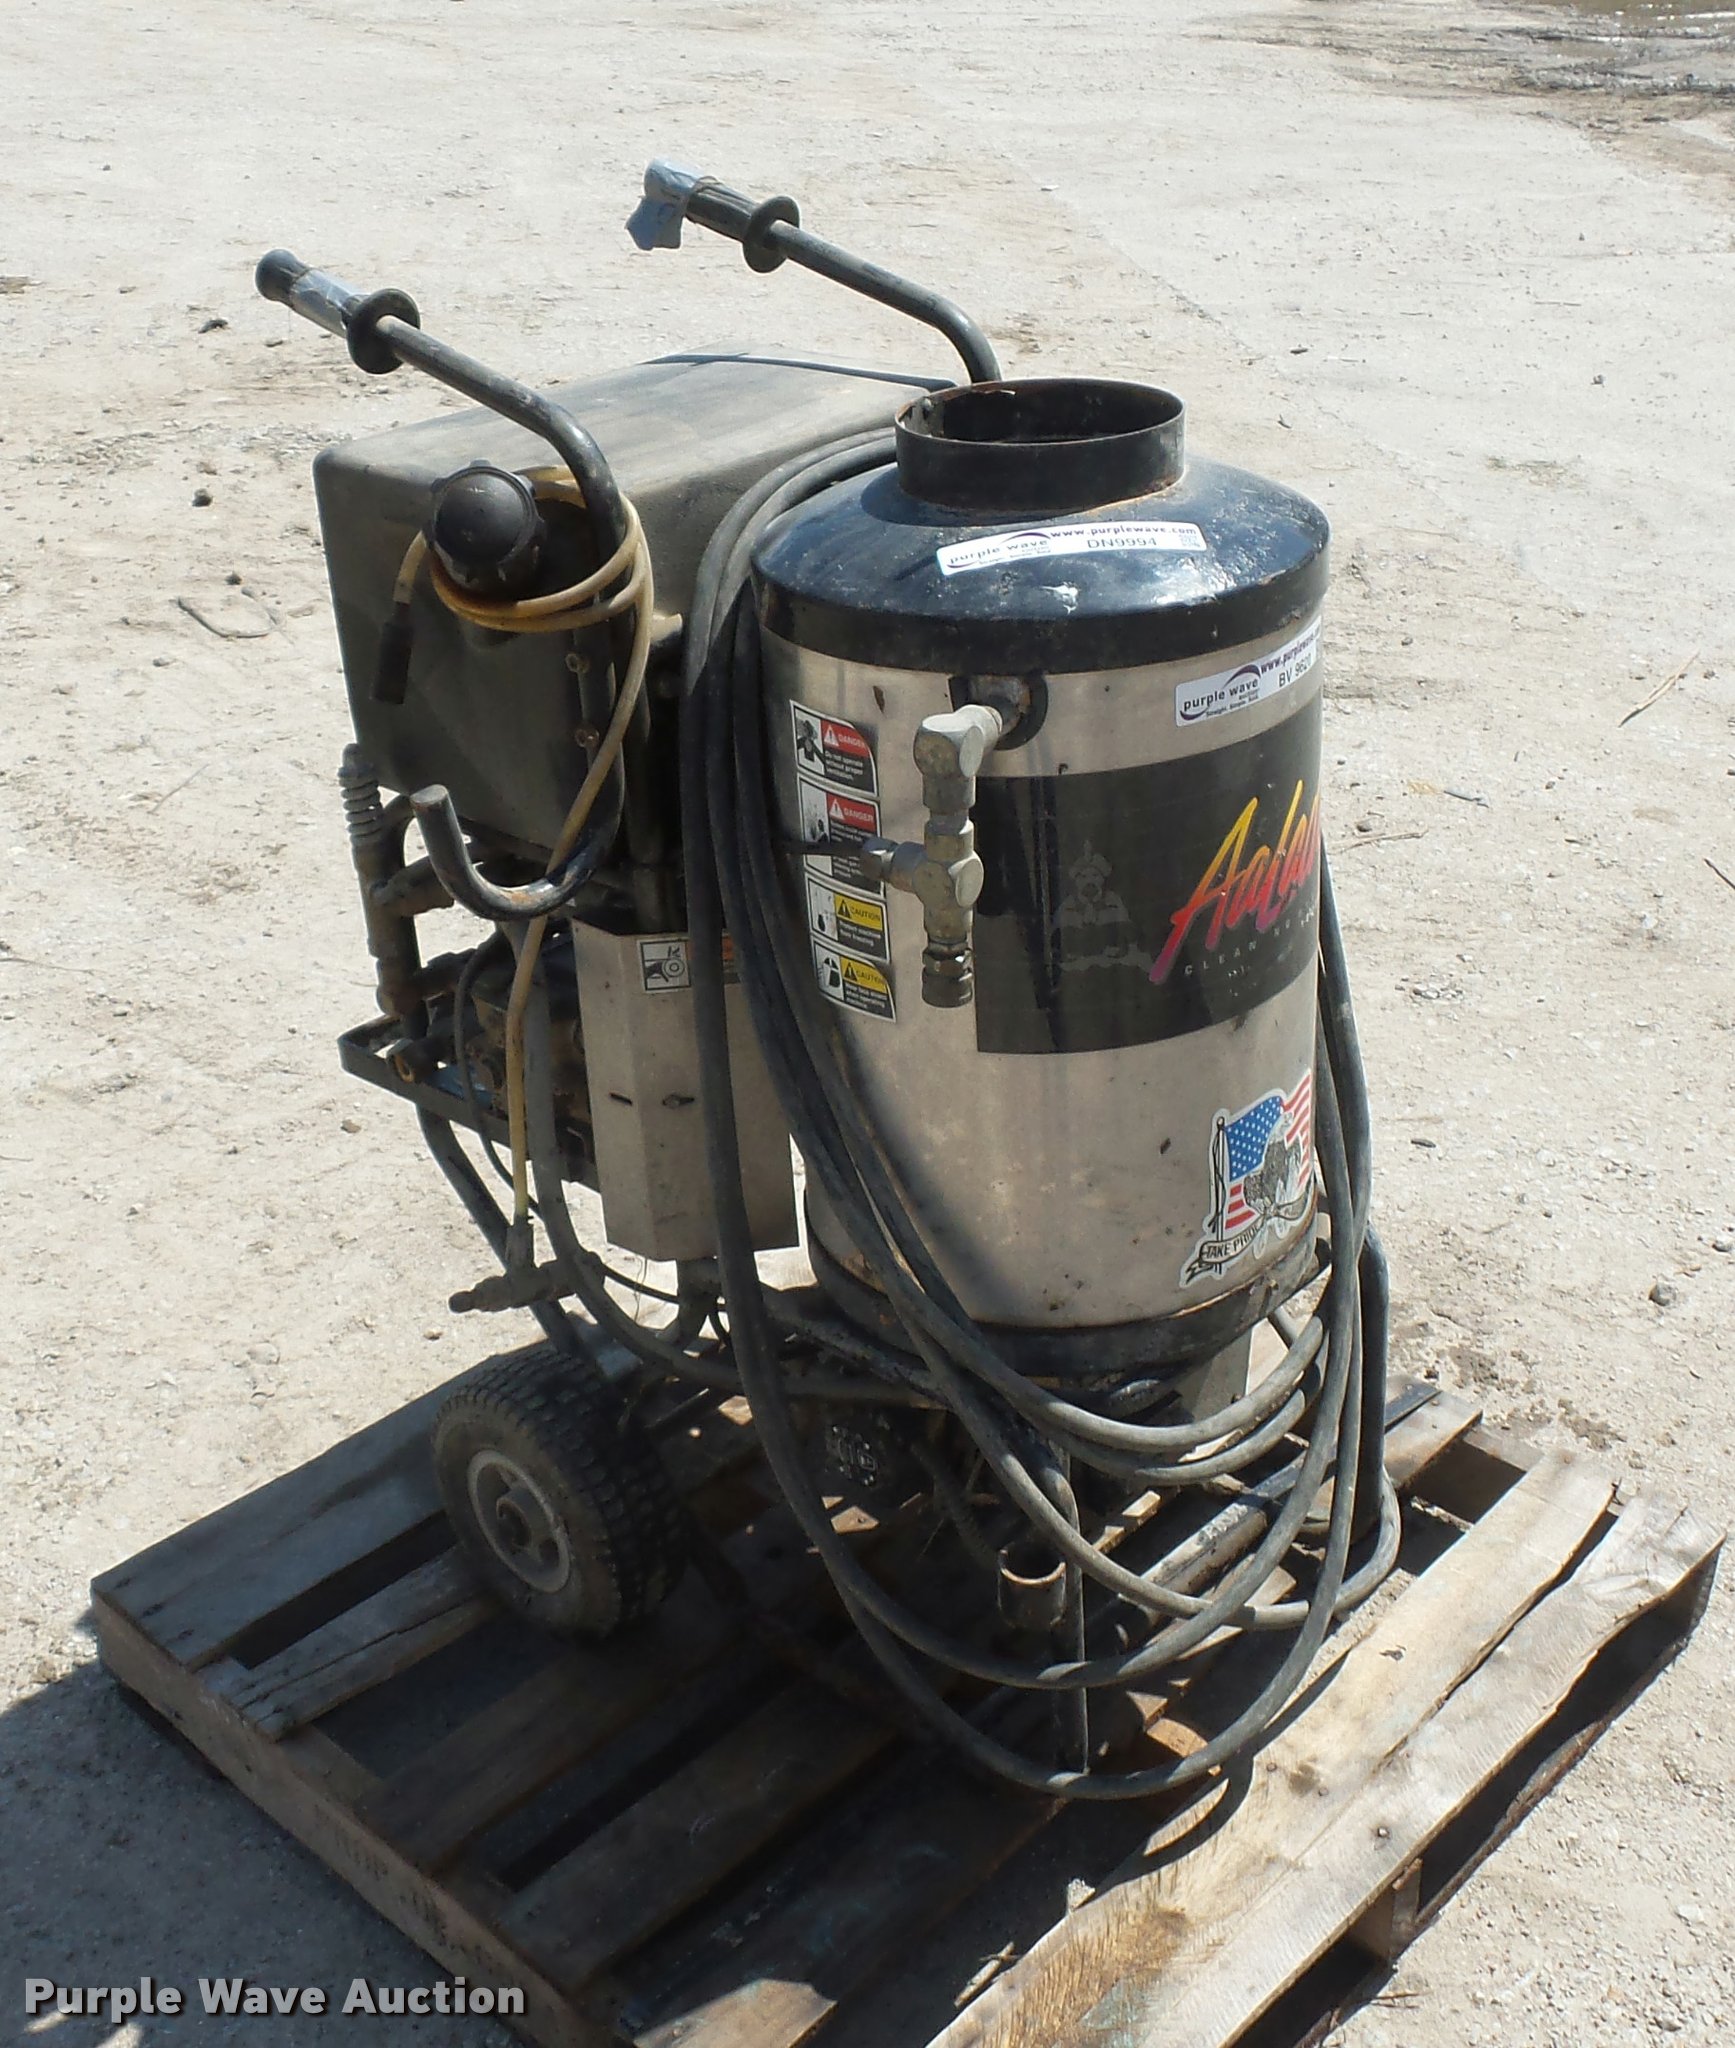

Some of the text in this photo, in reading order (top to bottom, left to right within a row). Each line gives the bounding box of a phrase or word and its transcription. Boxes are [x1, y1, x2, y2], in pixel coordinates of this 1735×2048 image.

[1051, 525, 1196, 538] www.purplewave.com
[1087, 537, 1157, 549] DN9994
[950, 547, 1000, 564] purple
[1007, 540, 1047, 550] wave
[1279, 667, 1292, 687] BV
[1183, 690, 1225, 712] purple
[1229, 678, 1258, 696] wave
[844, 808, 874, 822] DANGER
[851, 906, 881, 921] CAUTION
[1206, 1242, 1232, 1259] TAKE
